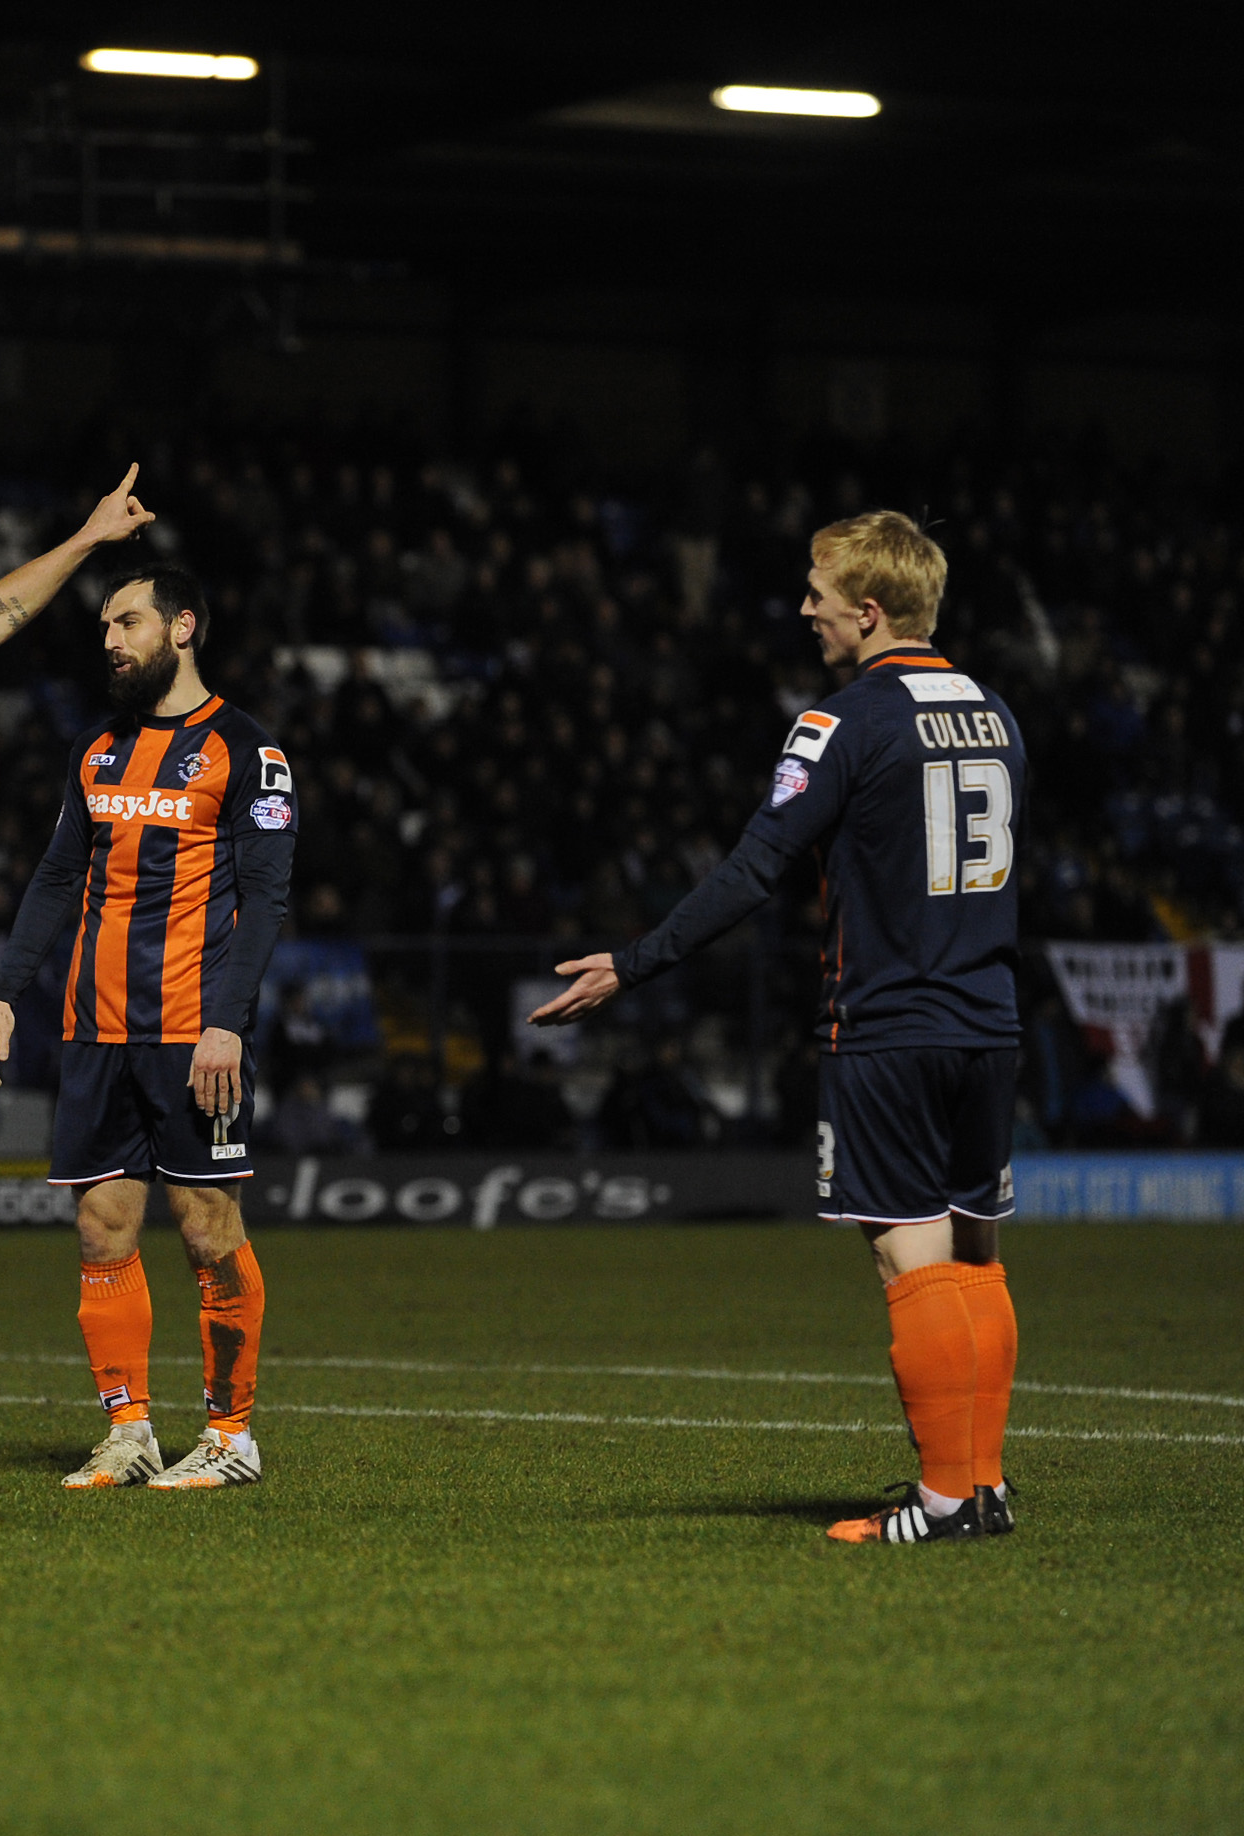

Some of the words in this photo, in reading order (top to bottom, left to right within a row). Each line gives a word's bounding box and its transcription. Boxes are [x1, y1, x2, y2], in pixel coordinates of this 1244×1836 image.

[915, 712, 1009, 749] CULLEN
[90, 755, 111, 765] FILA
[86, 790, 192, 821] easyJet
[923, 759, 1013, 896] 13
